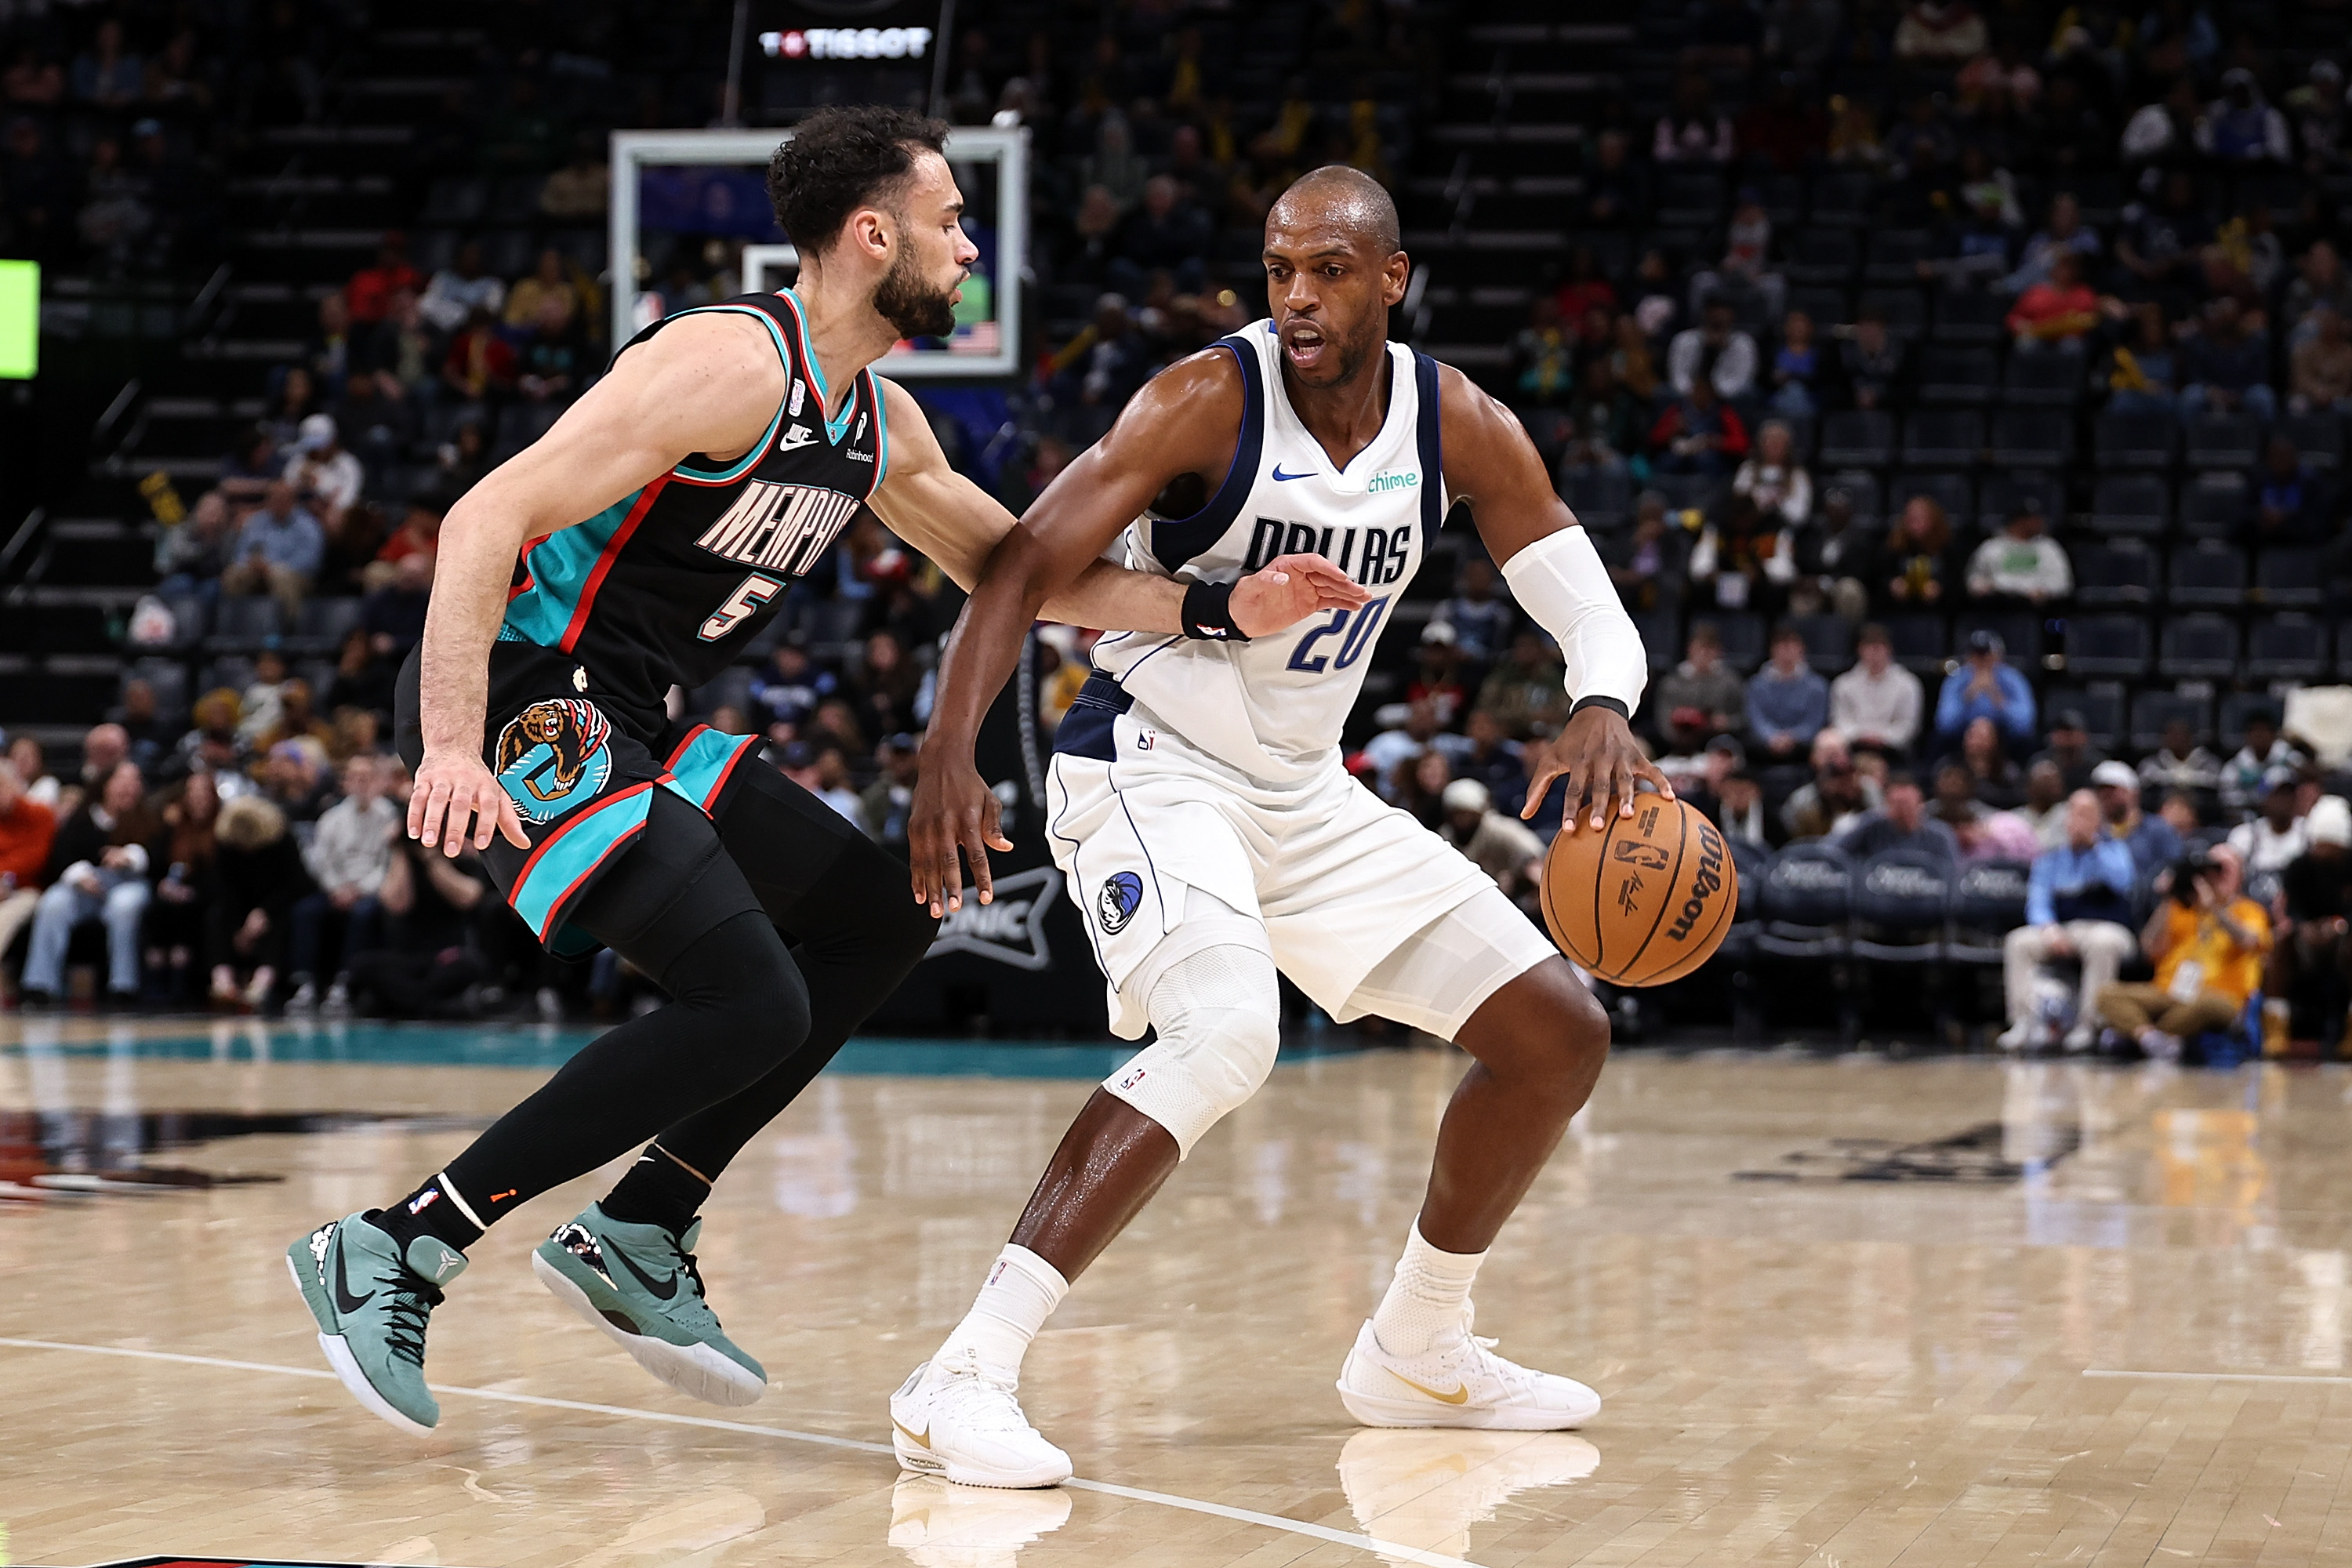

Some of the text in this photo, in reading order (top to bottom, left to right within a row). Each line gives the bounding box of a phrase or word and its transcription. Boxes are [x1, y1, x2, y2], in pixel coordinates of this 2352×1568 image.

[786, 423, 813, 443] NIKE
[845, 448, 874, 463] Robinhood
[1367, 470, 1418, 493] chime
[696, 571, 786, 642] 5
[1284, 592, 1393, 674] 20
[1664, 823, 1724, 942] Wilson
